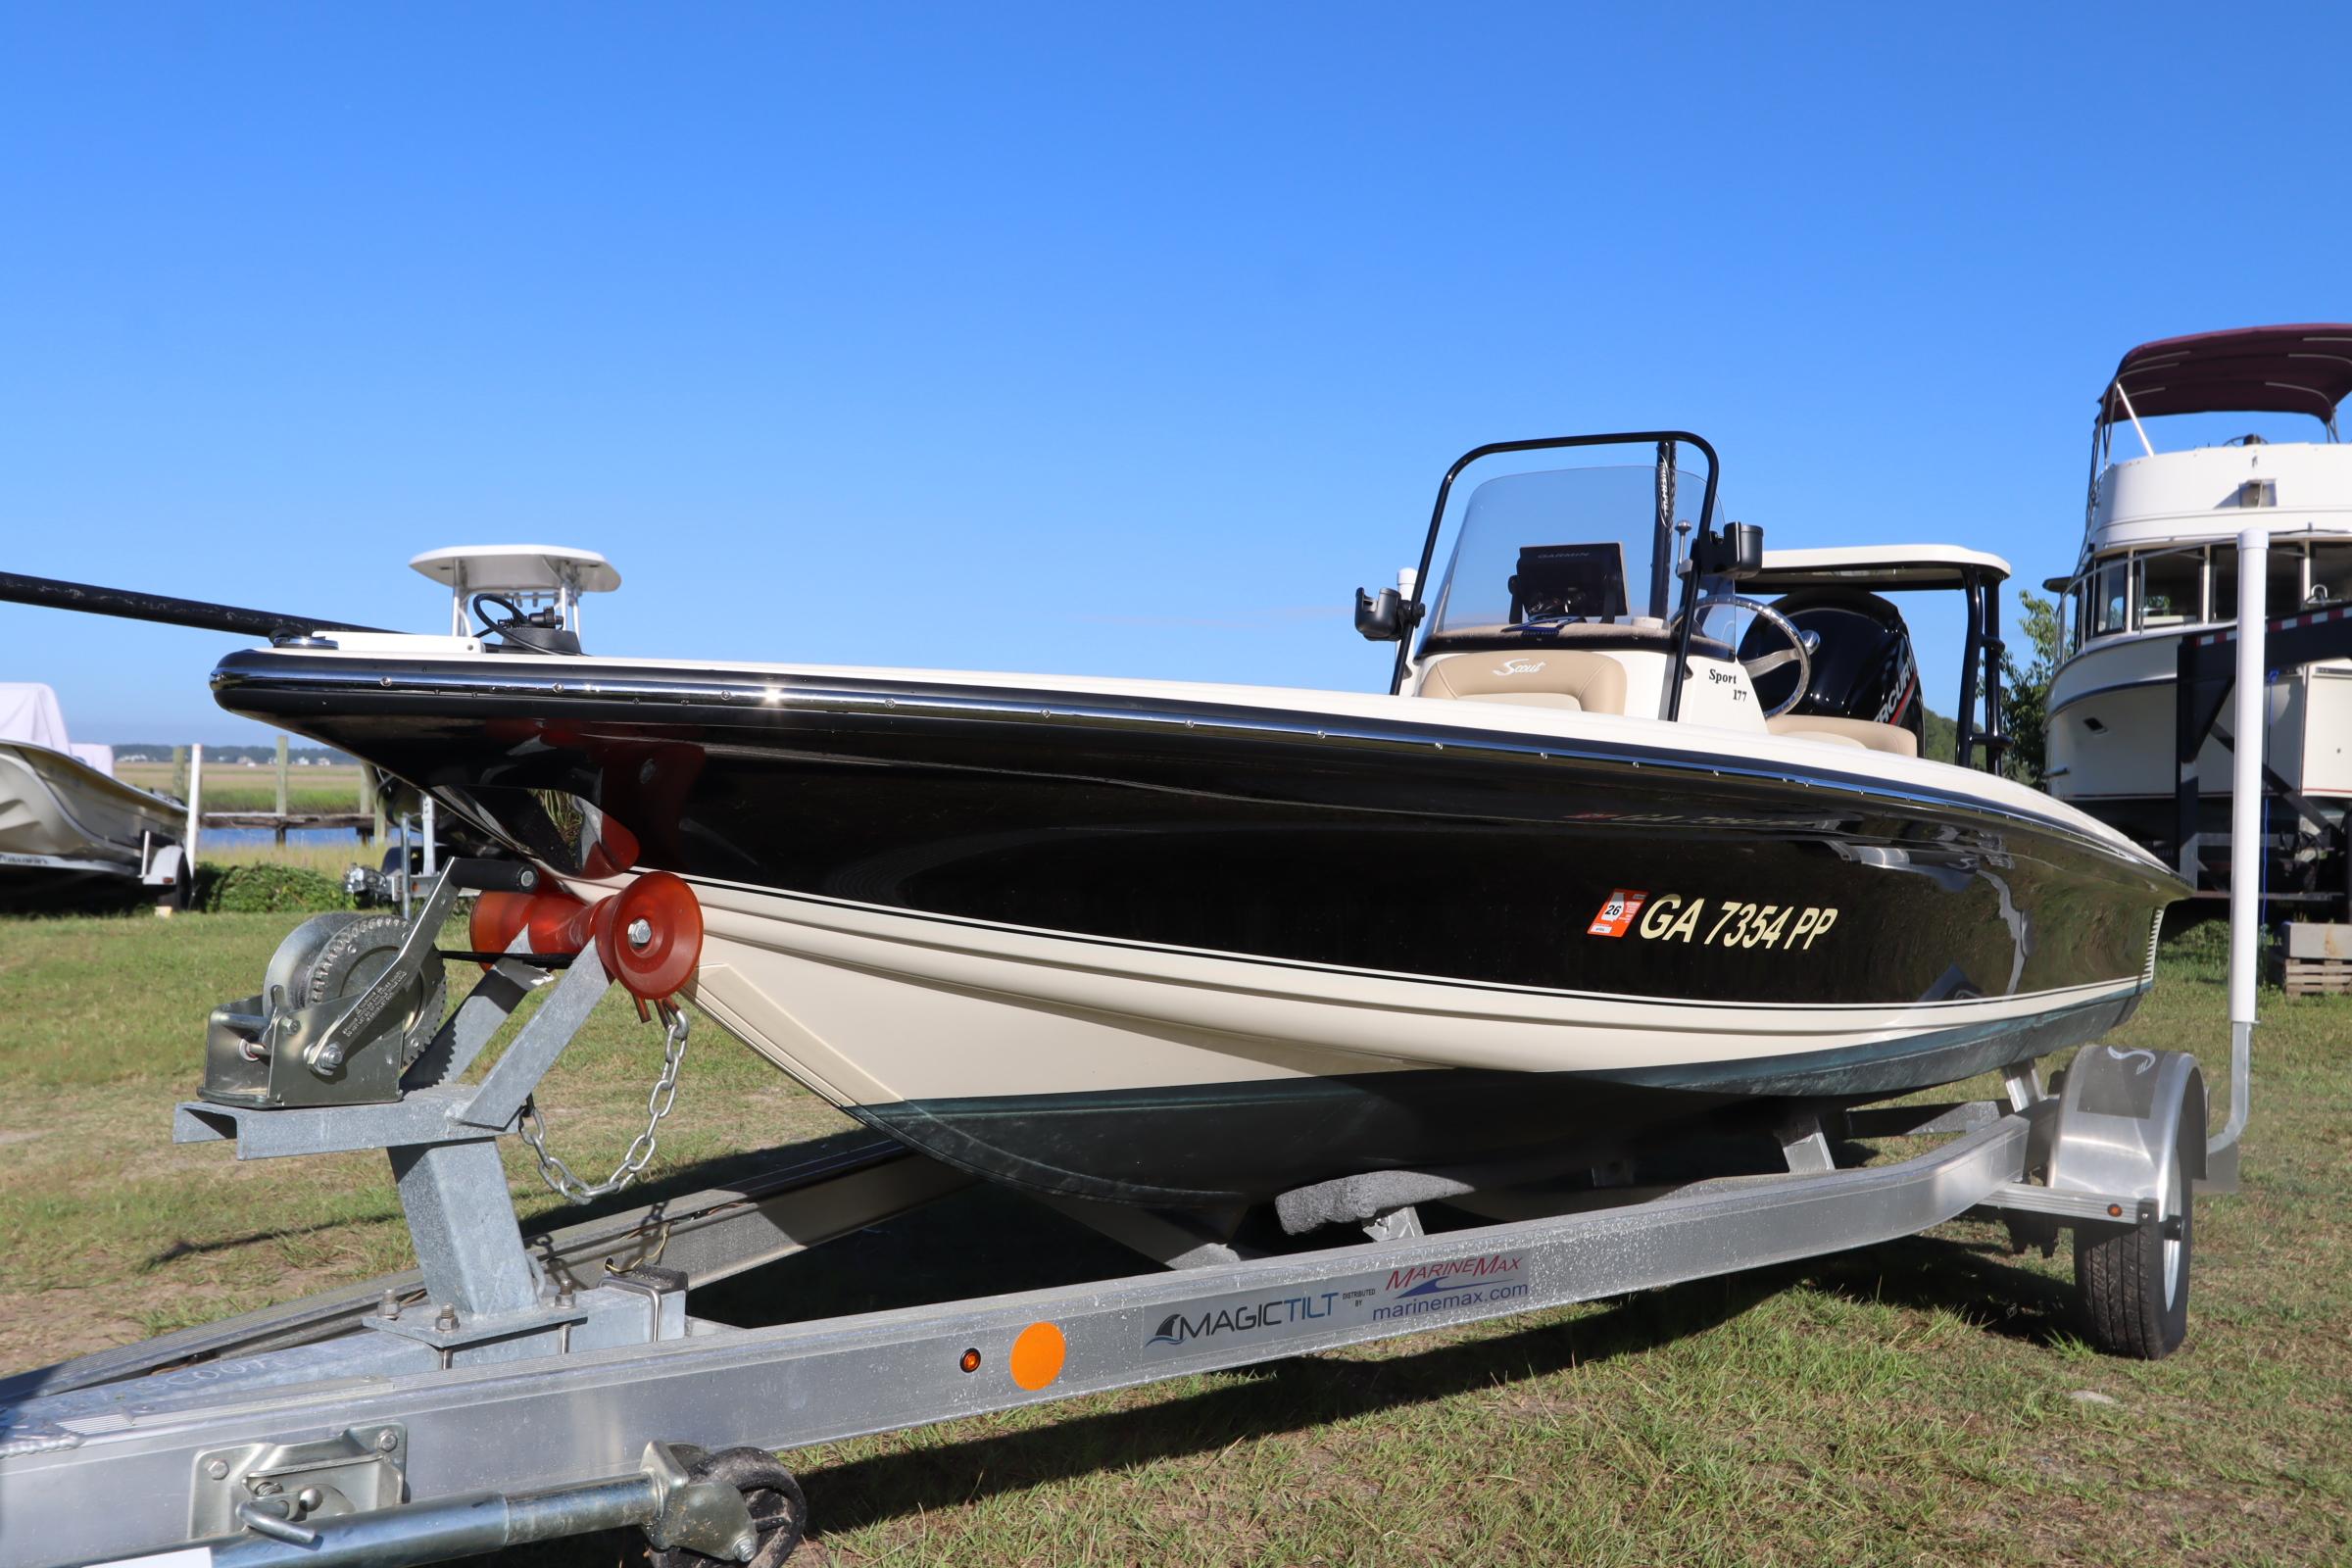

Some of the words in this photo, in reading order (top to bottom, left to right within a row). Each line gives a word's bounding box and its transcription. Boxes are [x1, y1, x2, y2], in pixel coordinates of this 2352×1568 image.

[1492, 658, 1546, 676] Scout
[1709, 668, 1737, 684] Sport
[1733, 689, 1747, 702] 177
[1604, 905, 1622, 915] 26
[1640, 894, 1705, 943] GA
[1704, 901, 1794, 950] 7354
[1783, 907, 1838, 951] PP
[1343, 1288, 1376, 1300] DISTRIBUTED
[1373, 1284, 1528, 1321] marinemax.com
[1179, 1292, 1339, 1339] MAGICTILT
